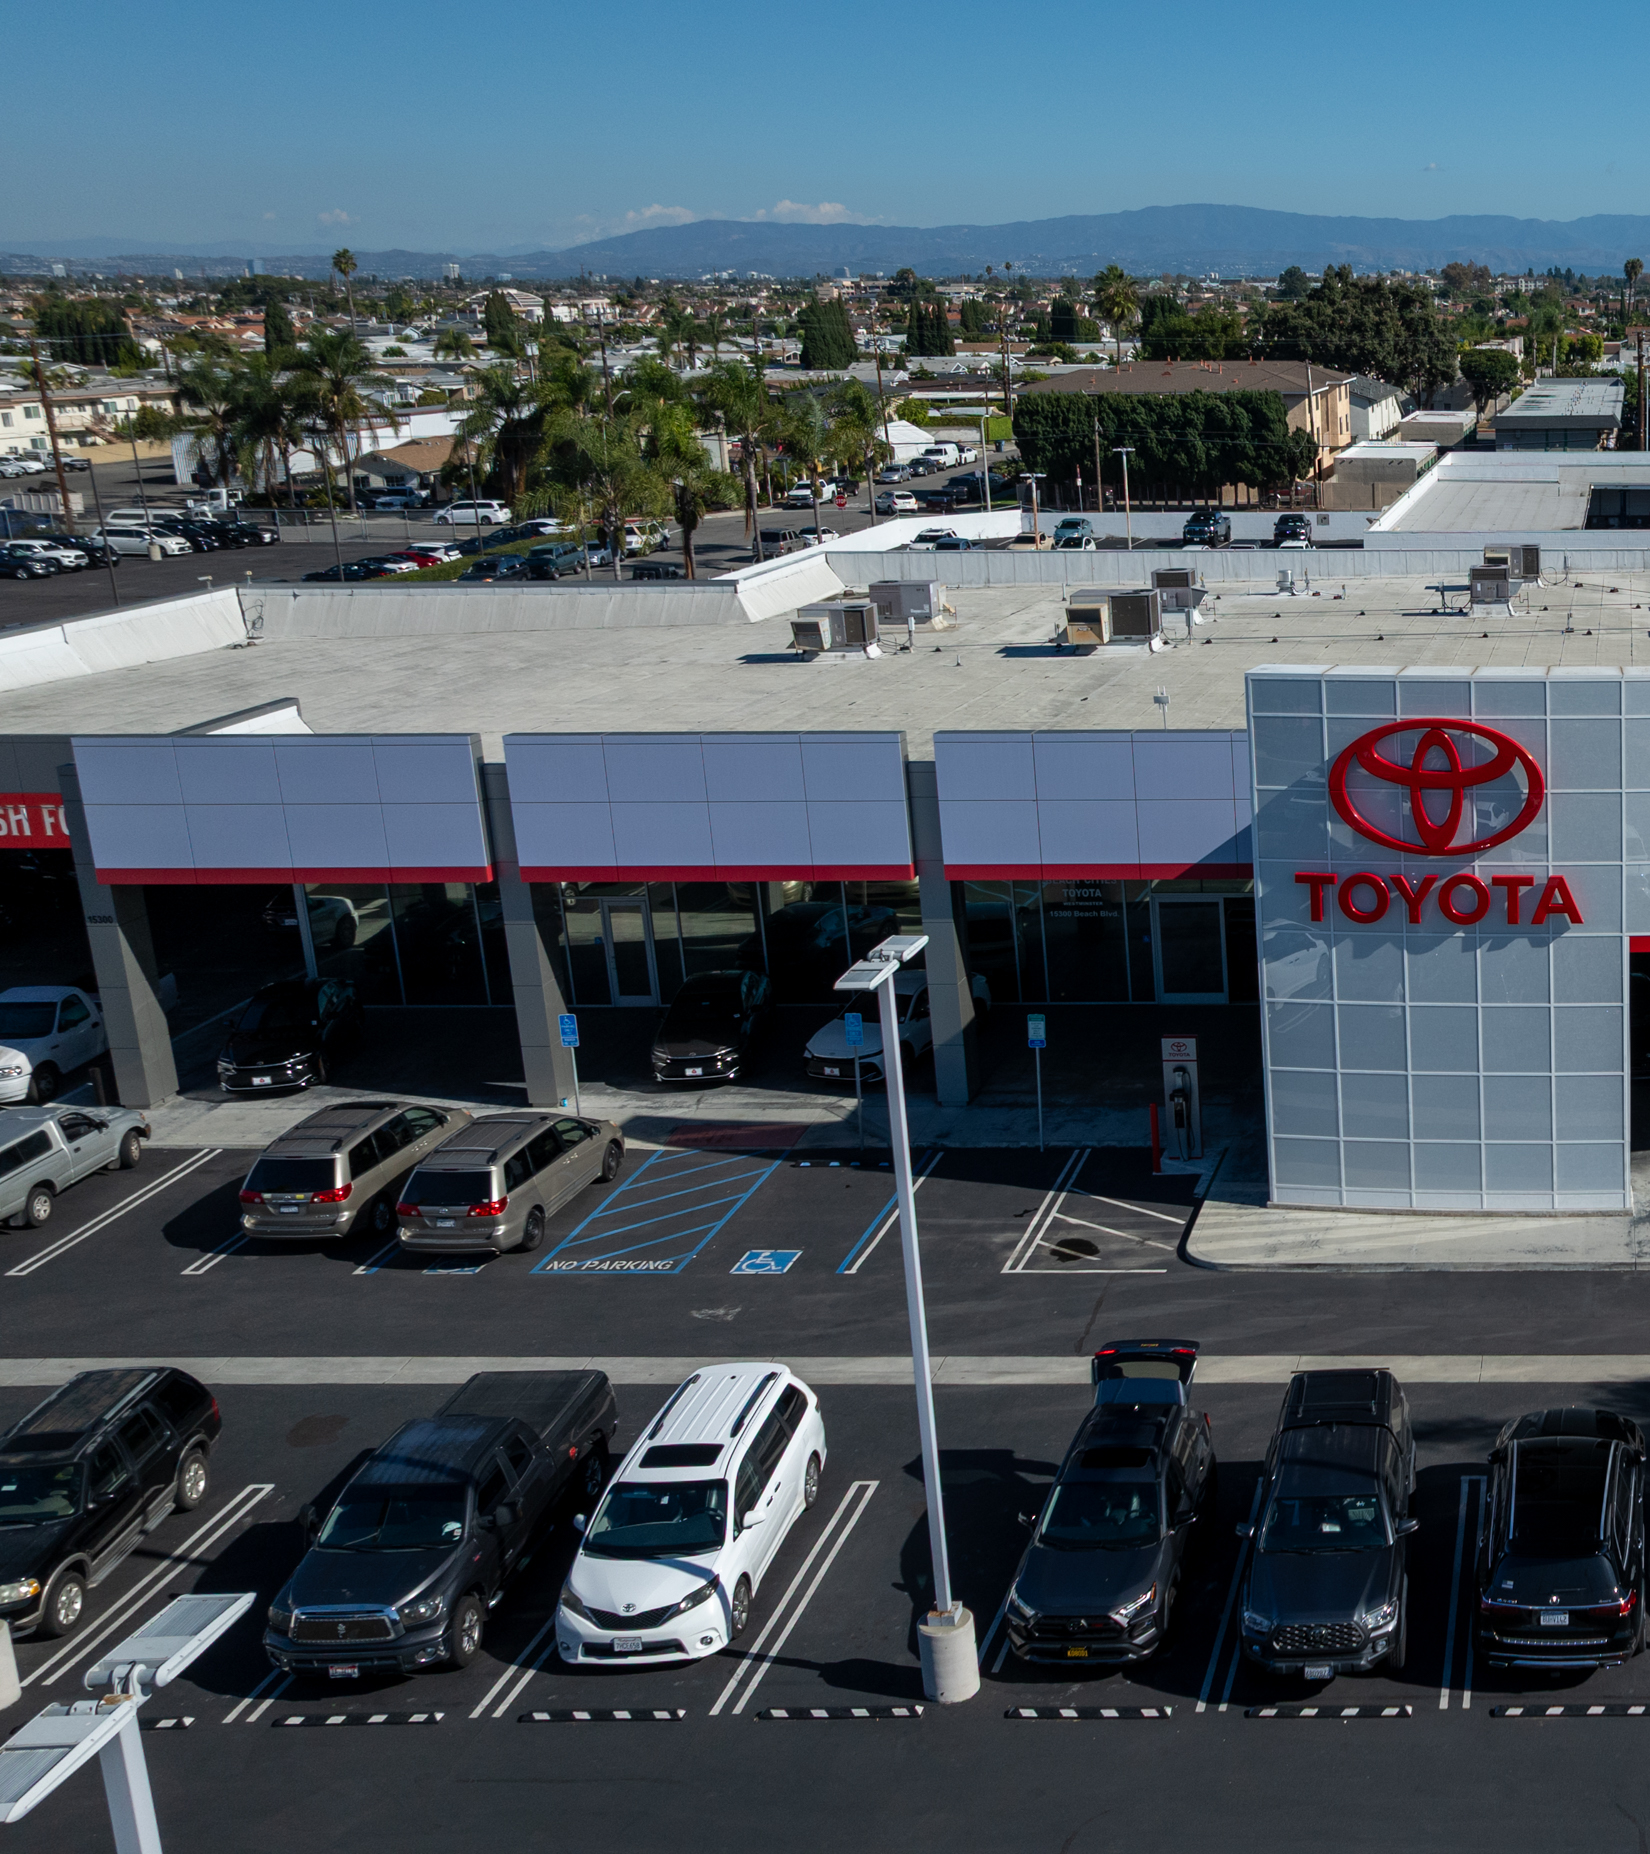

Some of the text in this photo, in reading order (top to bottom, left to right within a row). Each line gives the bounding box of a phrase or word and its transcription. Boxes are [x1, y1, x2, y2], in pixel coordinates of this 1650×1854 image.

[1062, 888, 1102, 898] TOYOTA
[1294, 872, 1584, 925] TOYOTA
[1049, 910, 1120, 918] 15300 Beach Blvd.
[87, 915, 114, 924] 15300
[545, 1260, 675, 1271] NO PARKING
